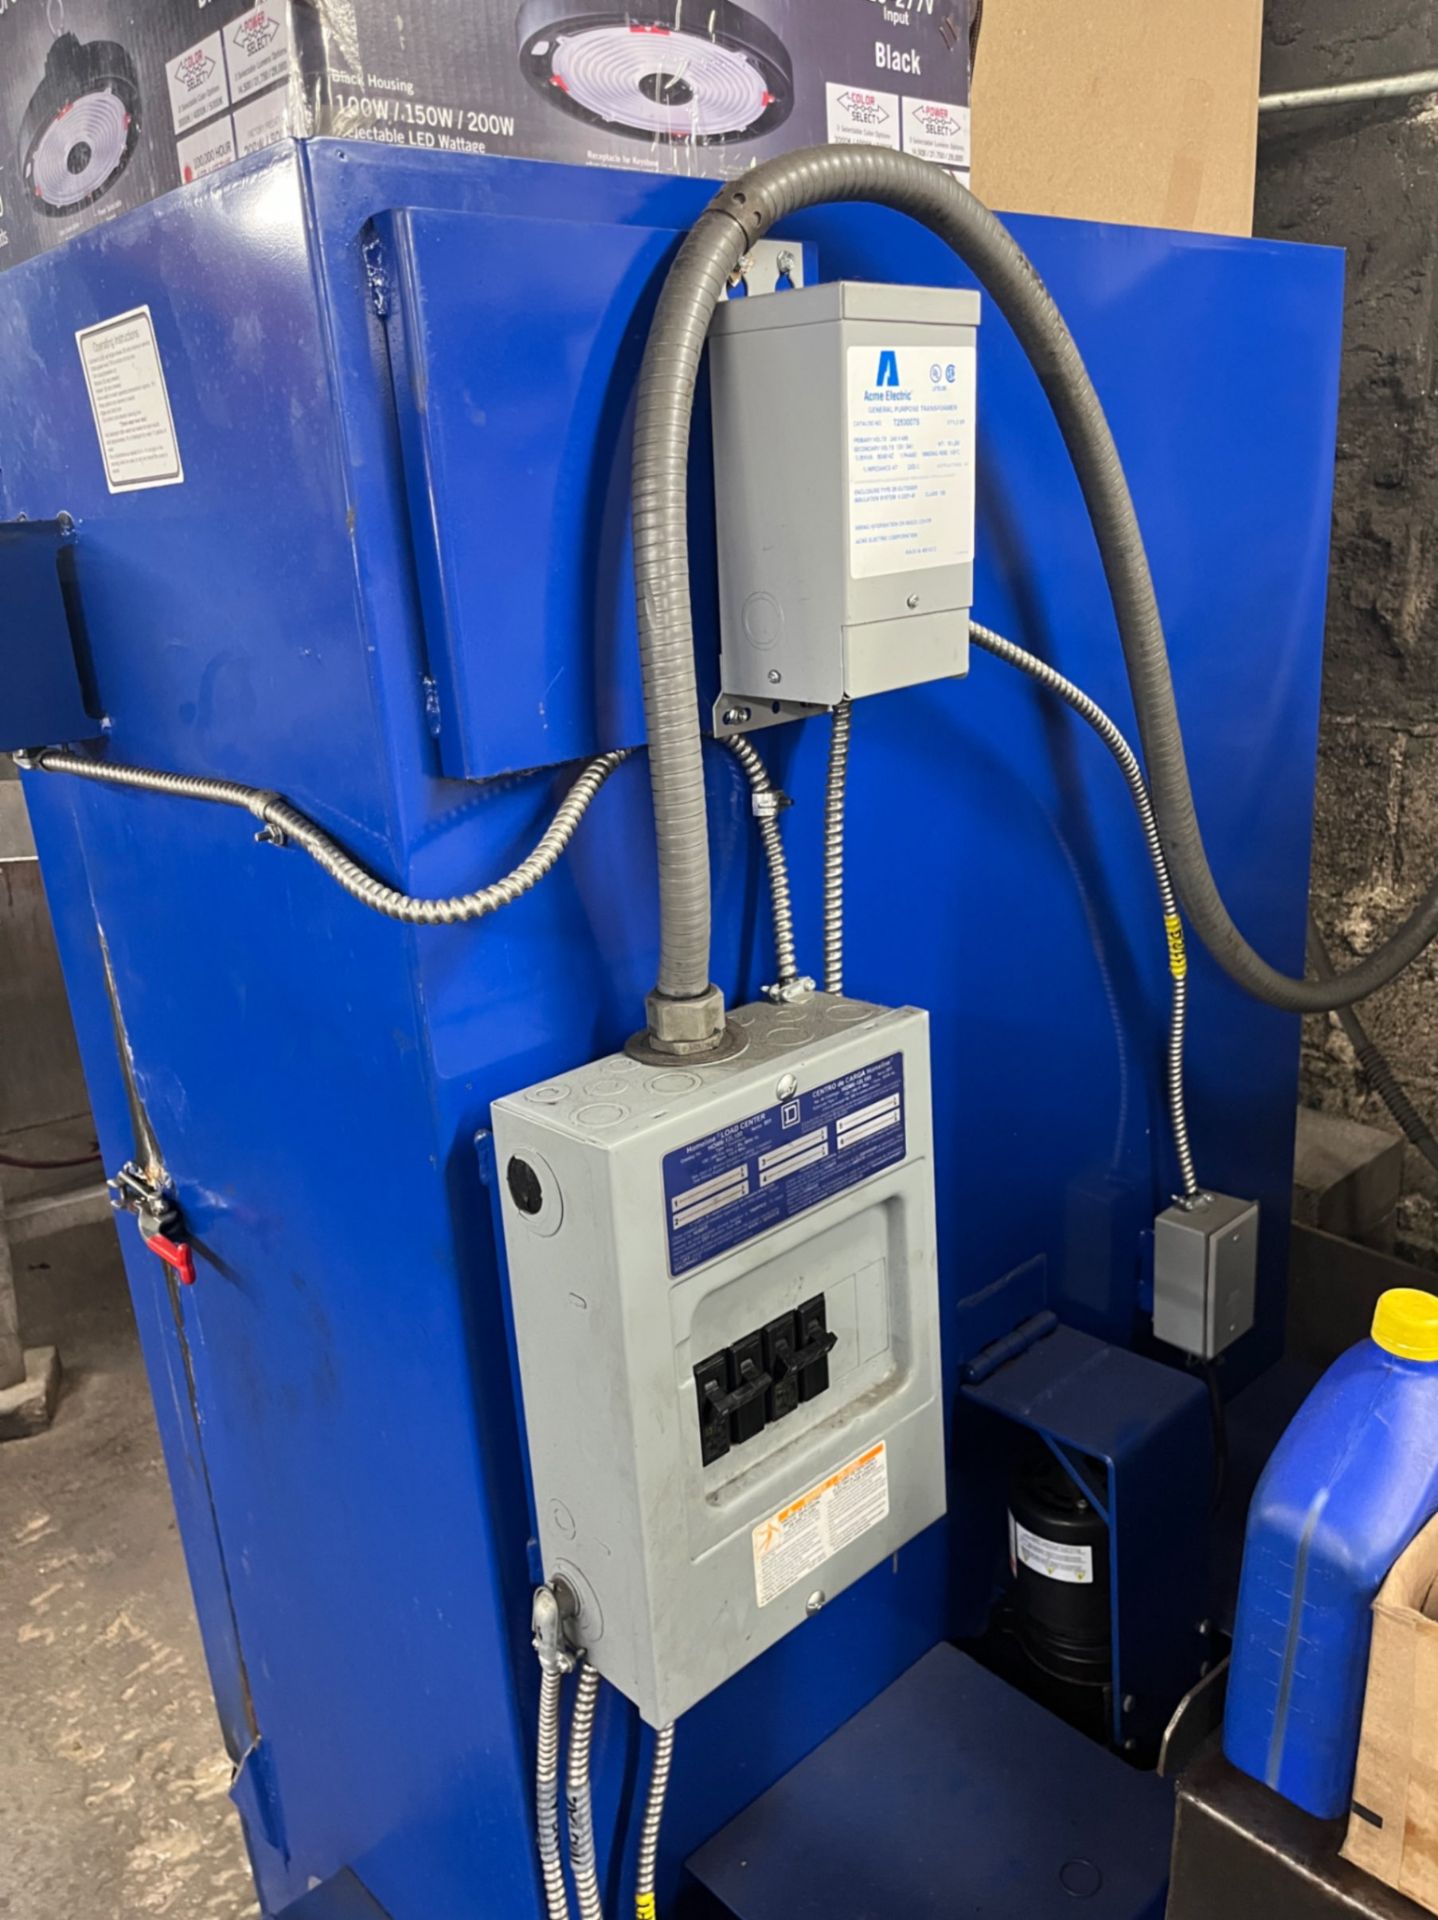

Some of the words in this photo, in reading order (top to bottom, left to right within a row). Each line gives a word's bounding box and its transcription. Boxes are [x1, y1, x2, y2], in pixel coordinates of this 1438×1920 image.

[884, 5, 910, 26] Input
[246, 34, 272, 57] SELECT
[875, 41, 921, 75] Black
[186, 70, 208, 92] SELECT
[367, 73, 415, 96] Housing
[851, 92, 876, 105] COLOR
[336, 94, 388, 120] 100W
[405, 103, 453, 129] 150W
[458, 110, 463, 130] /
[467, 111, 514, 136] 200W
[851, 111, 877, 124] SELECT
[925, 105, 949, 118] POWER
[925, 123, 950, 136] SELECT
[409, 131, 435, 147] LED
[438, 134, 486, 154] Wattage
[864, 390, 884, 402] Acme
[885, 389, 912, 402] Electric
[868, 405, 894, 414] GENERAL
[894, 404, 919, 413] PURPOSE
[920, 403, 958, 412] TRANSFORMER
[812, 1083, 837, 1098] CENTRO
[845, 1069, 866, 1084] CARGA
[686, 1136, 717, 1154] Homeline
[720, 1124, 740, 1138] LOAD
[740, 1113, 767, 1130] CENTER
